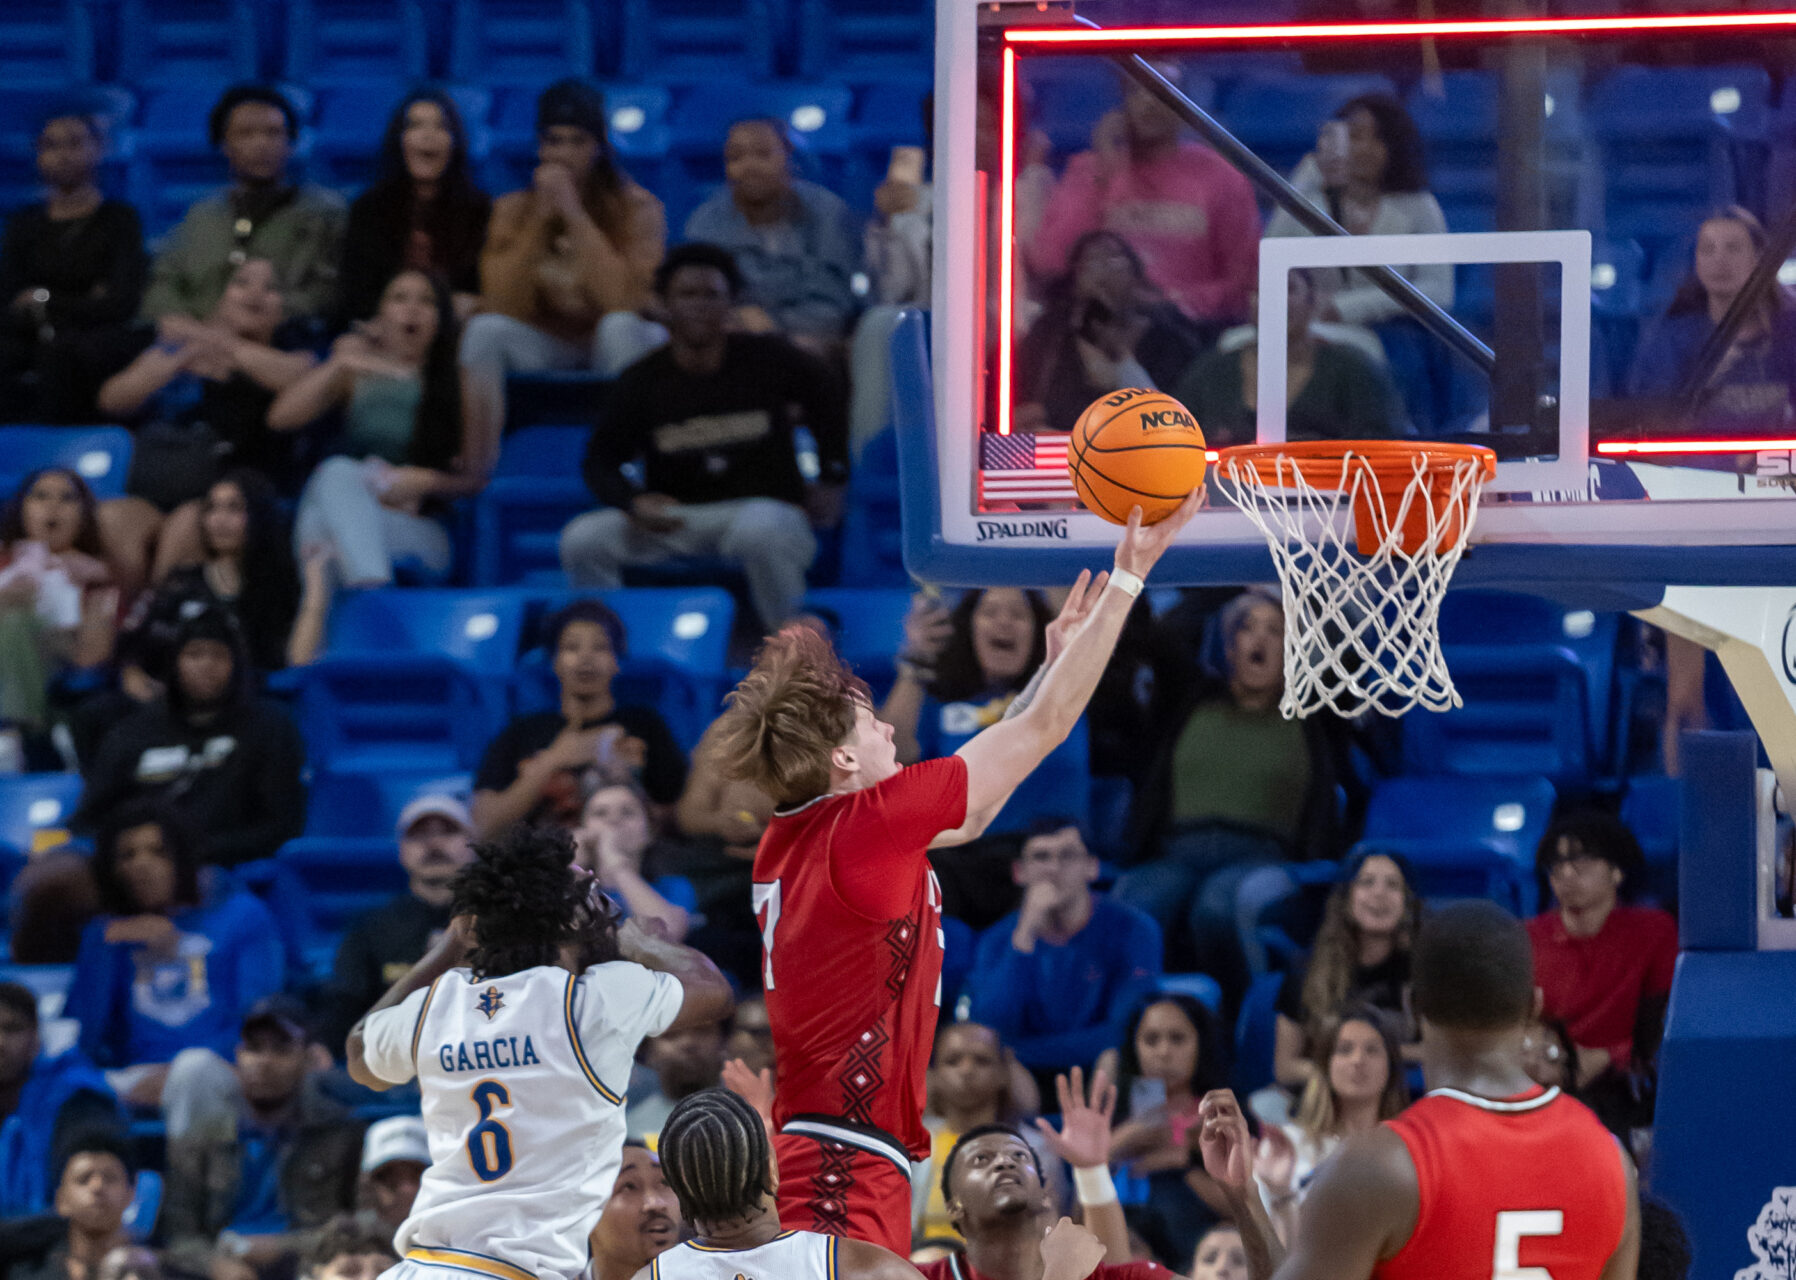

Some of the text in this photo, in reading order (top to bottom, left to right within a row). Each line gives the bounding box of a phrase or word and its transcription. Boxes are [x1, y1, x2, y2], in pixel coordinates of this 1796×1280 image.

[1139, 410, 1197, 431] NCAA
[977, 518, 1068, 541] SPALDING
[439, 1034, 541, 1072] GARCIA
[465, 1078, 516, 1184] 6
